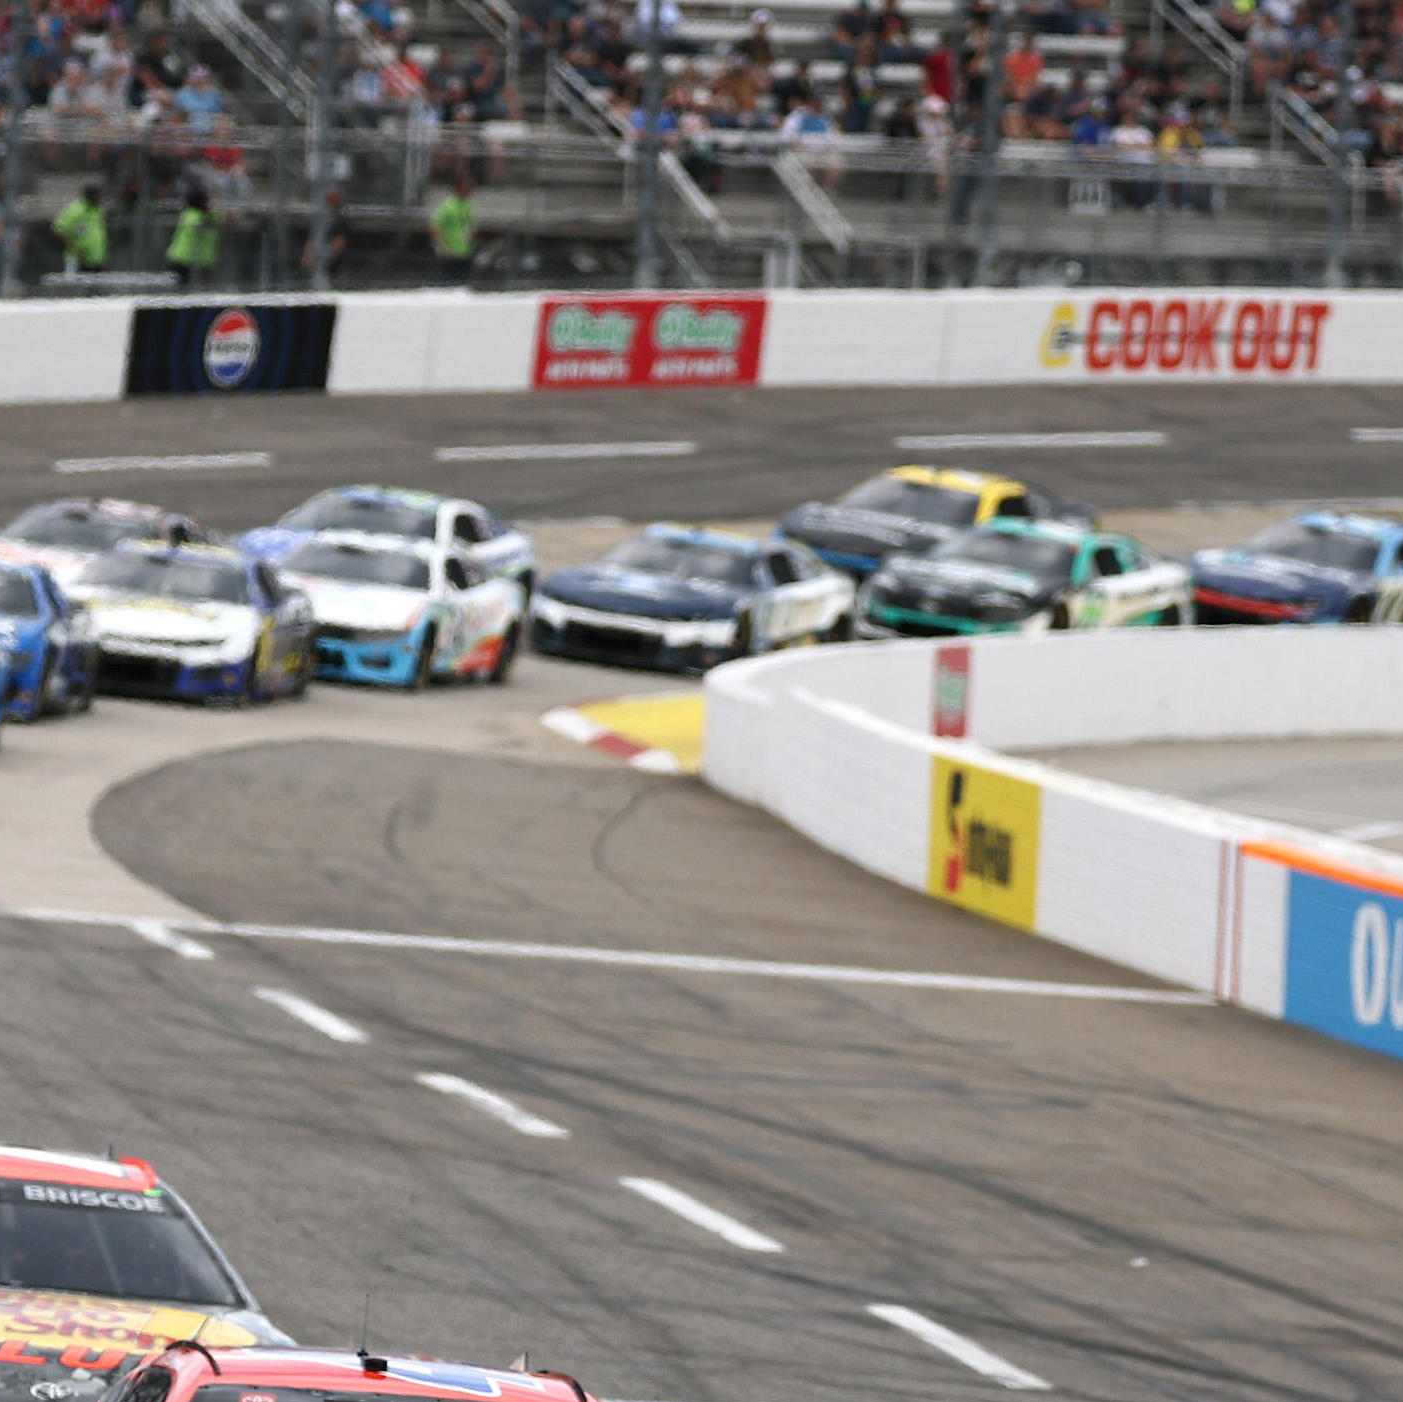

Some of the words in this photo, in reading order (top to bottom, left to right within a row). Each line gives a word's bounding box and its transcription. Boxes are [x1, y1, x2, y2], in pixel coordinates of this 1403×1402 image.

[1084, 300, 1219, 373] COOK
[1230, 300, 1332, 373] OUT
[23, 1184, 165, 1214] BRISCOE
